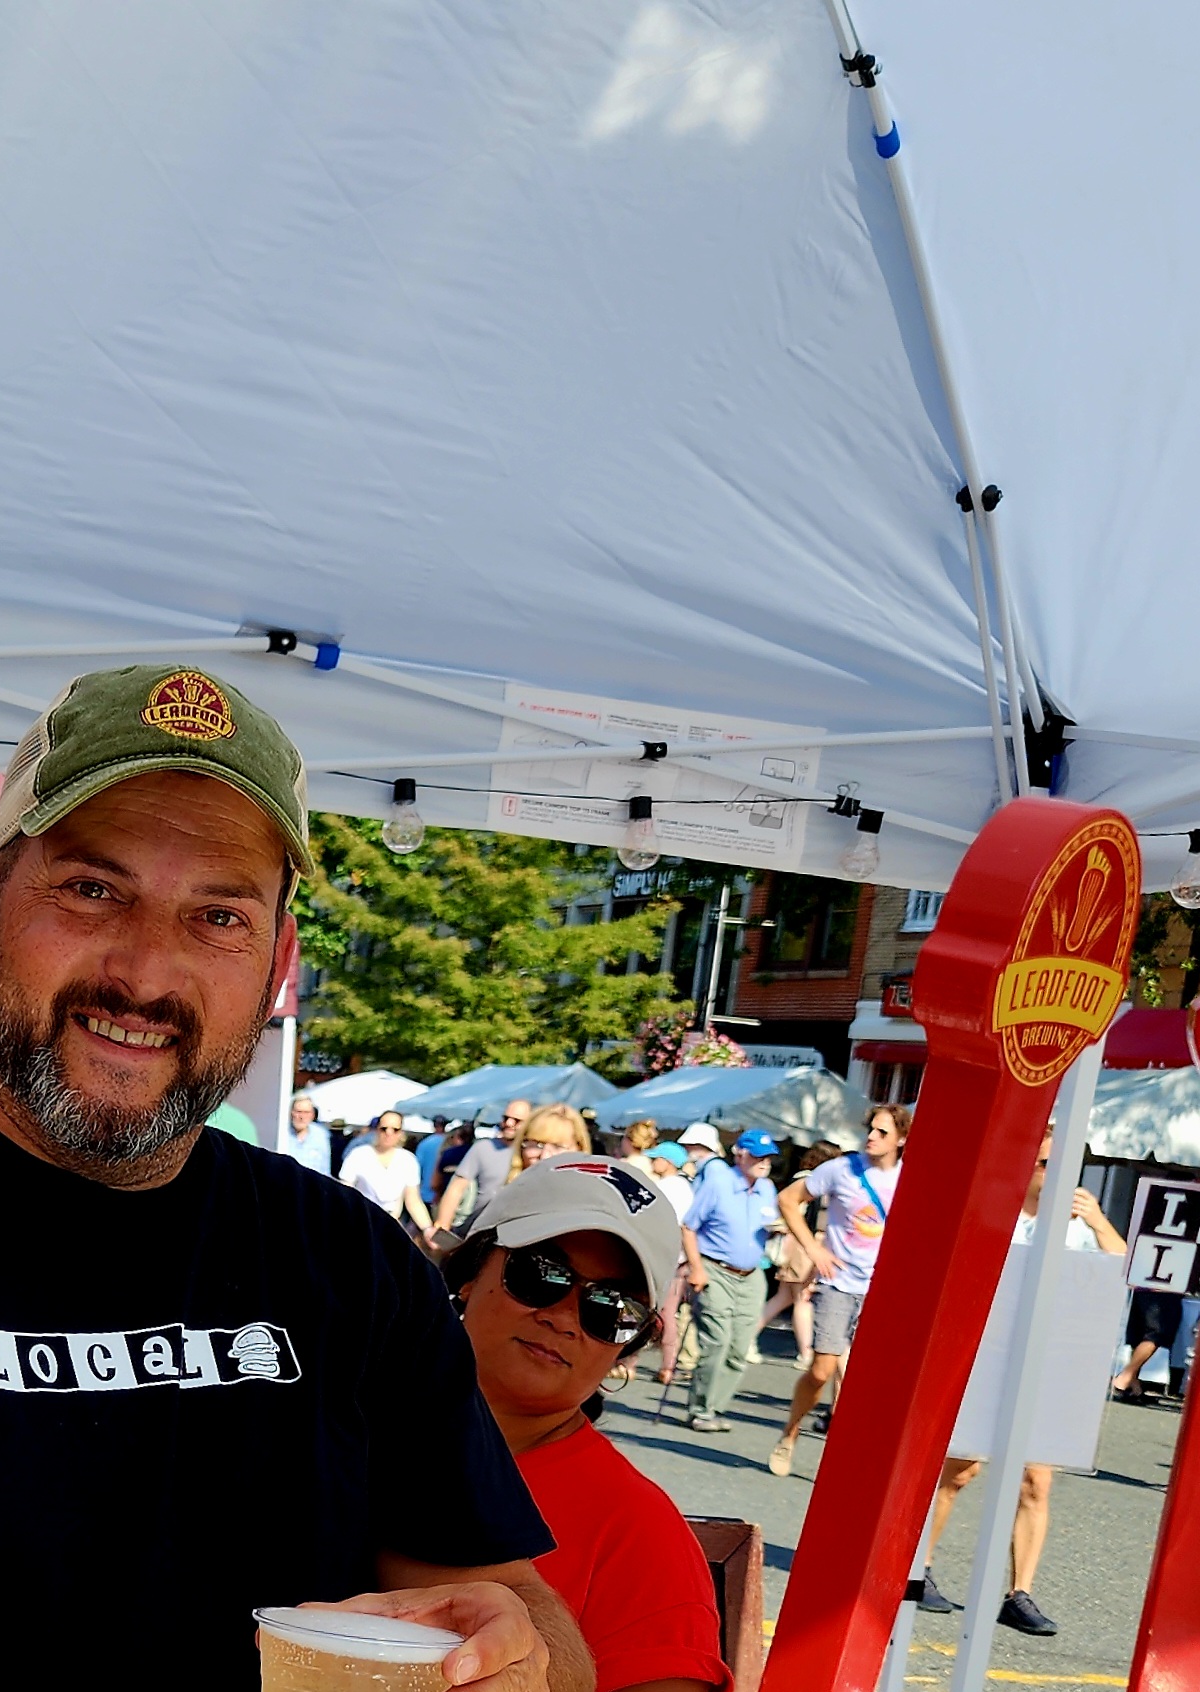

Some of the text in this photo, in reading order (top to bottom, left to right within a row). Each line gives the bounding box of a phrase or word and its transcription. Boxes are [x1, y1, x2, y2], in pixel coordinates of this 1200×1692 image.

[149, 705, 228, 731] LEADFOOT
[1008, 969, 1110, 1016] LEADFOOT
[1020, 1024, 1071, 1050] BREWING
